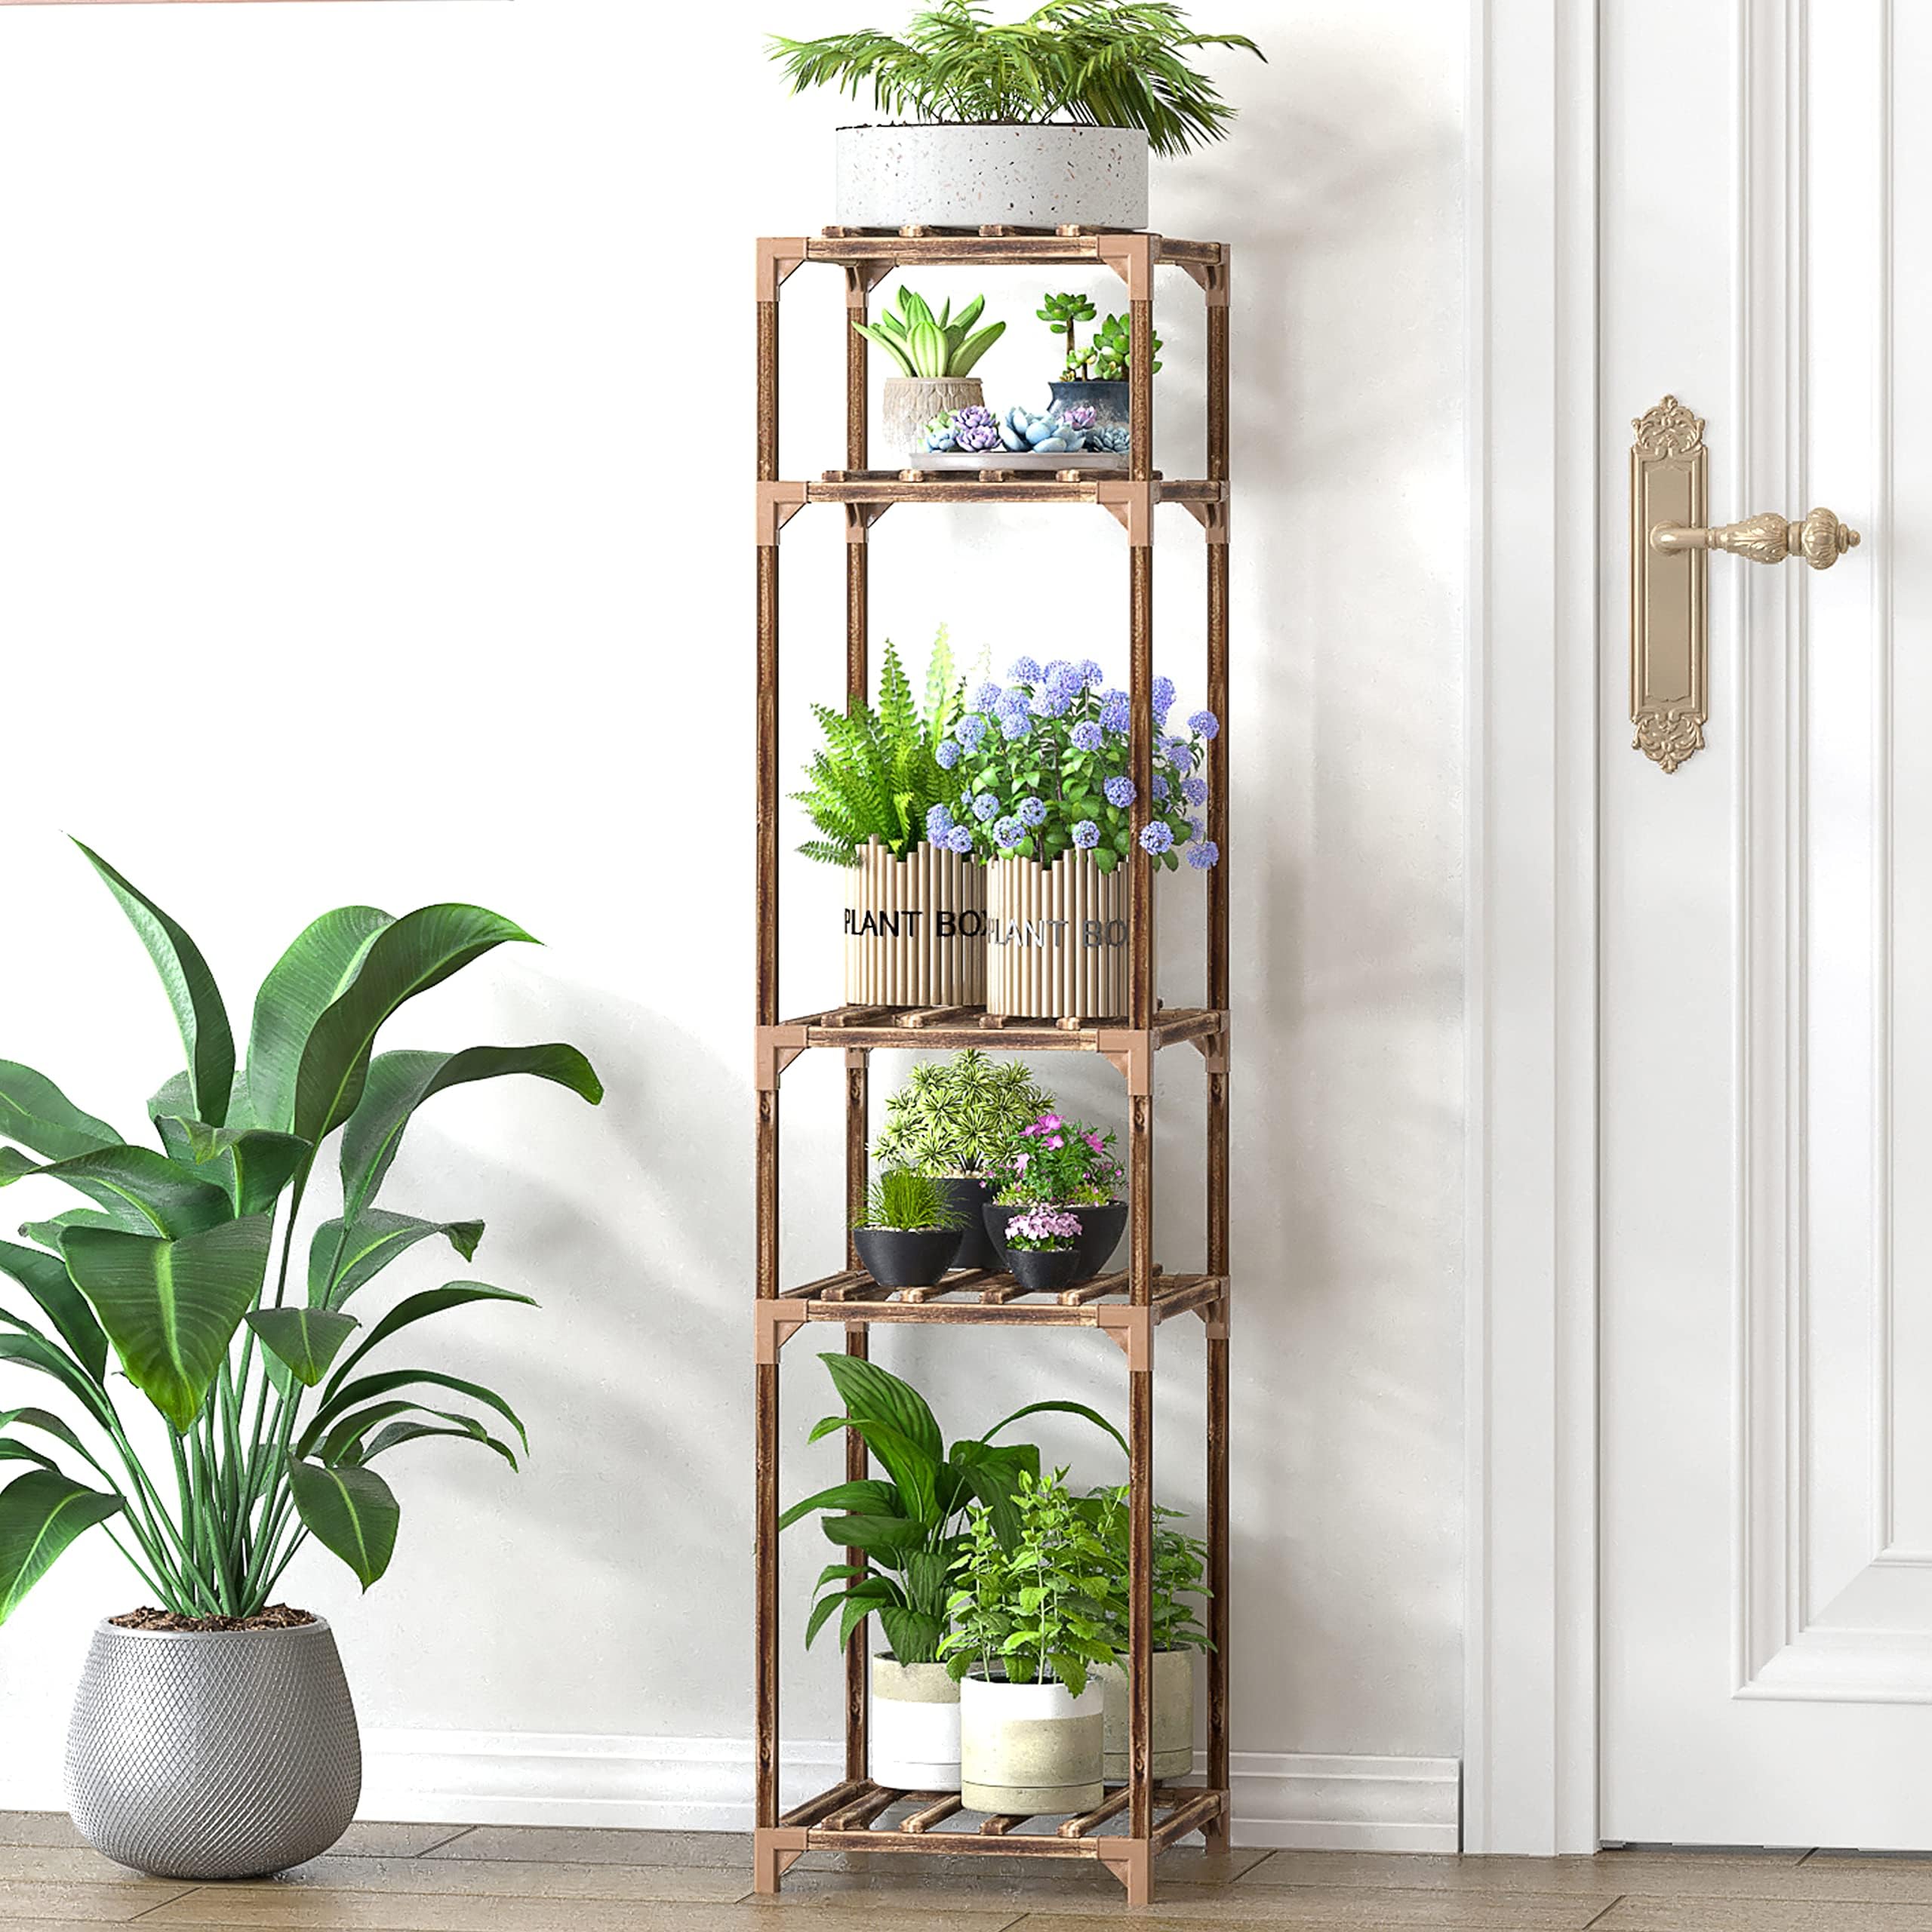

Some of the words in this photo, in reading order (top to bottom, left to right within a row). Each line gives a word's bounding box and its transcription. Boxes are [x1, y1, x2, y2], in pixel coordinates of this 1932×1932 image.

[844, 908, 923, 937] PLANT
[986, 918, 1069, 947] PLANT
[1082, 919, 1128, 947] BO
